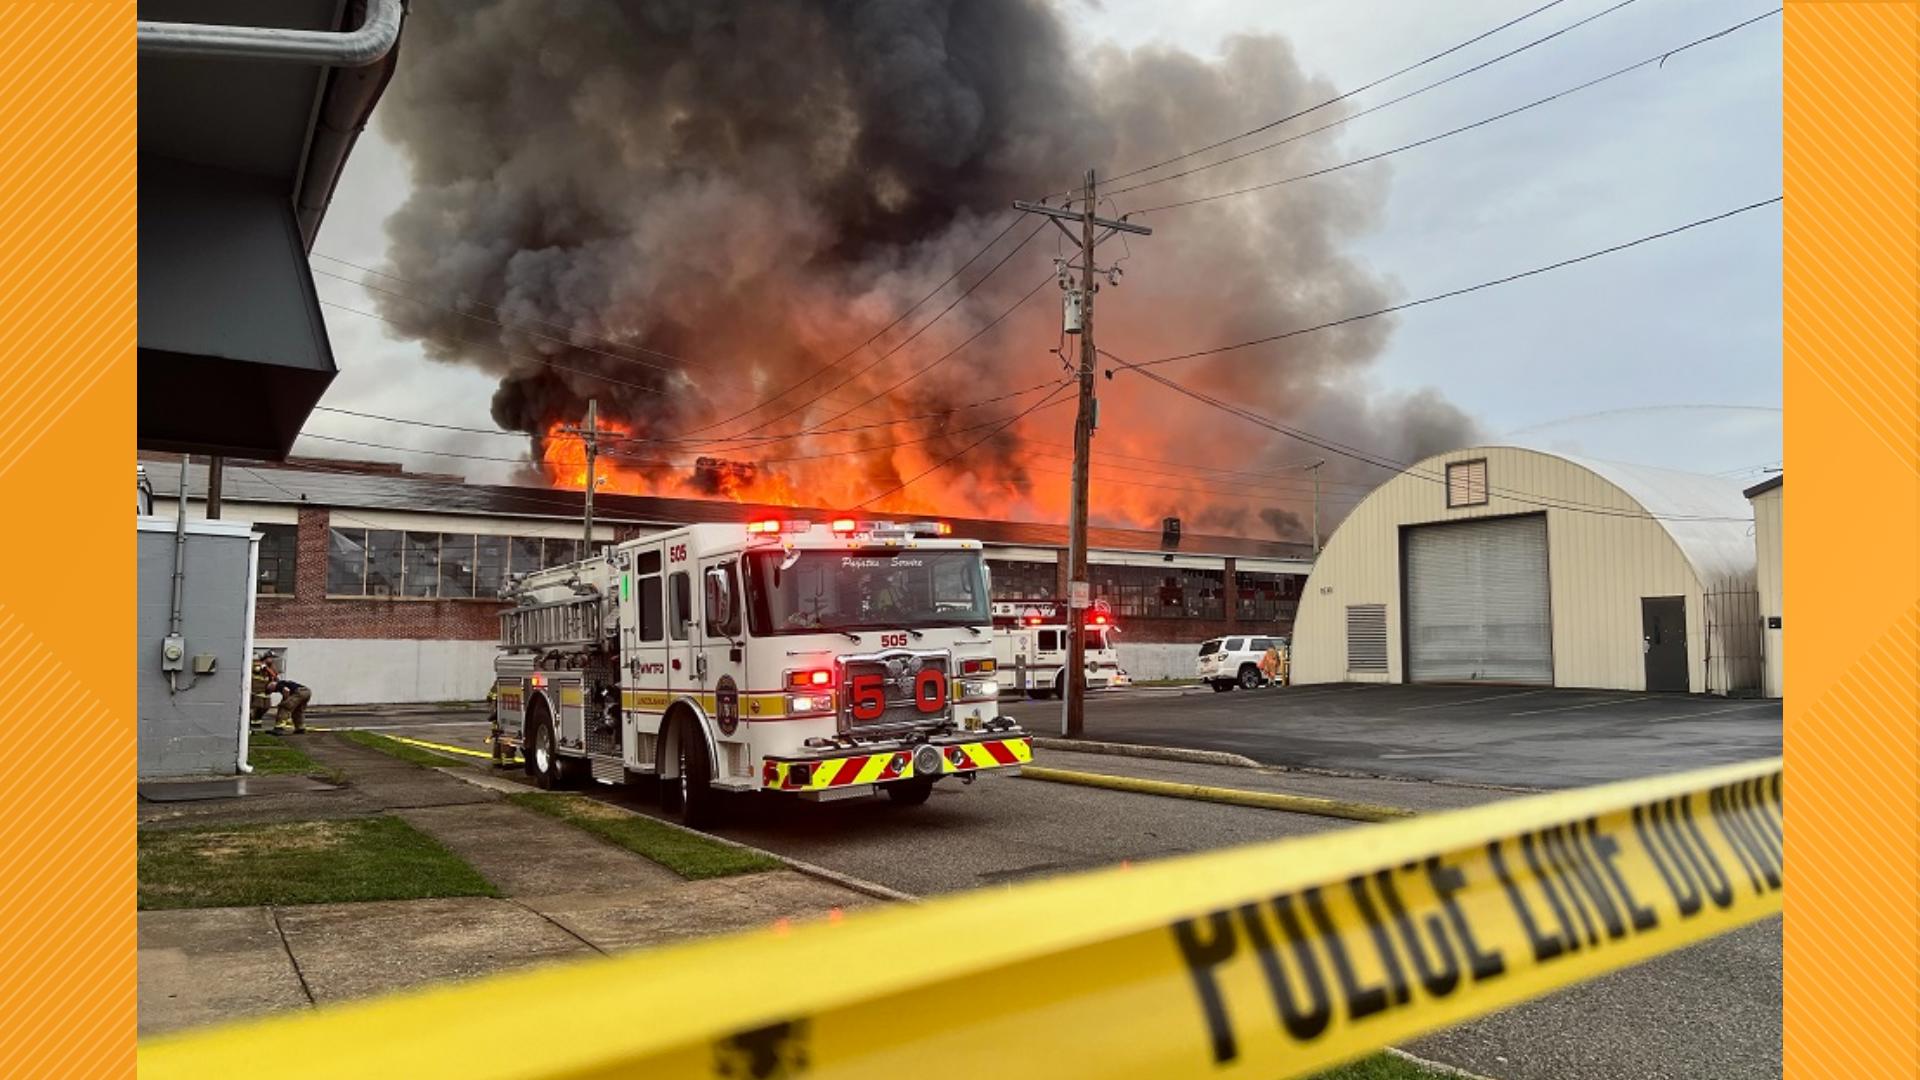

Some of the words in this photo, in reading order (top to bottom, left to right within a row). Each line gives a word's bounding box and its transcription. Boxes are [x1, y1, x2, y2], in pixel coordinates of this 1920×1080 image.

[670, 544, 687, 563] 505
[881, 634, 908, 647] 505
[1174, 855, 1504, 1064] POLICE
[1488, 817, 1659, 963] LINE
[1631, 794, 1734, 919] DO
